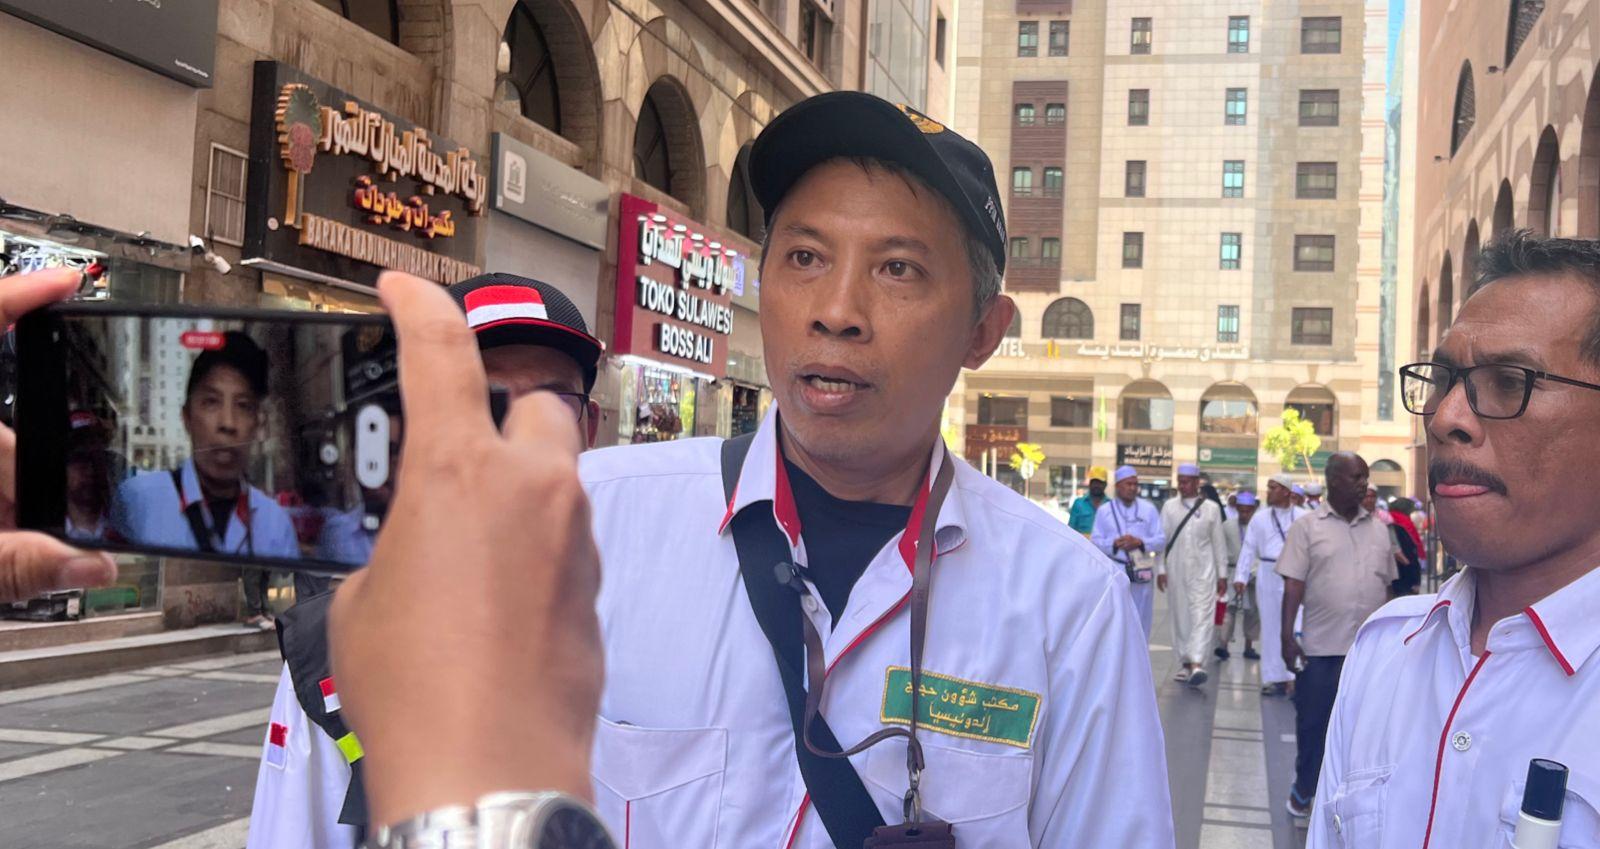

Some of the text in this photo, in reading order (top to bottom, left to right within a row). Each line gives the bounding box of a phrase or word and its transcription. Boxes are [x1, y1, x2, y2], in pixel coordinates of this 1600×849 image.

[320, 101, 369, 156] للتمور
[416, 128, 461, 195] المدينة
[306, 215, 351, 257] BARAKA
[639, 275, 734, 335] TOKO SULAWESI
[660, 323, 713, 364] BOSS ALI
[904, 681, 1019, 711] مكتب شؤون حجج
[929, 702, 991, 733] إندونيسيا
